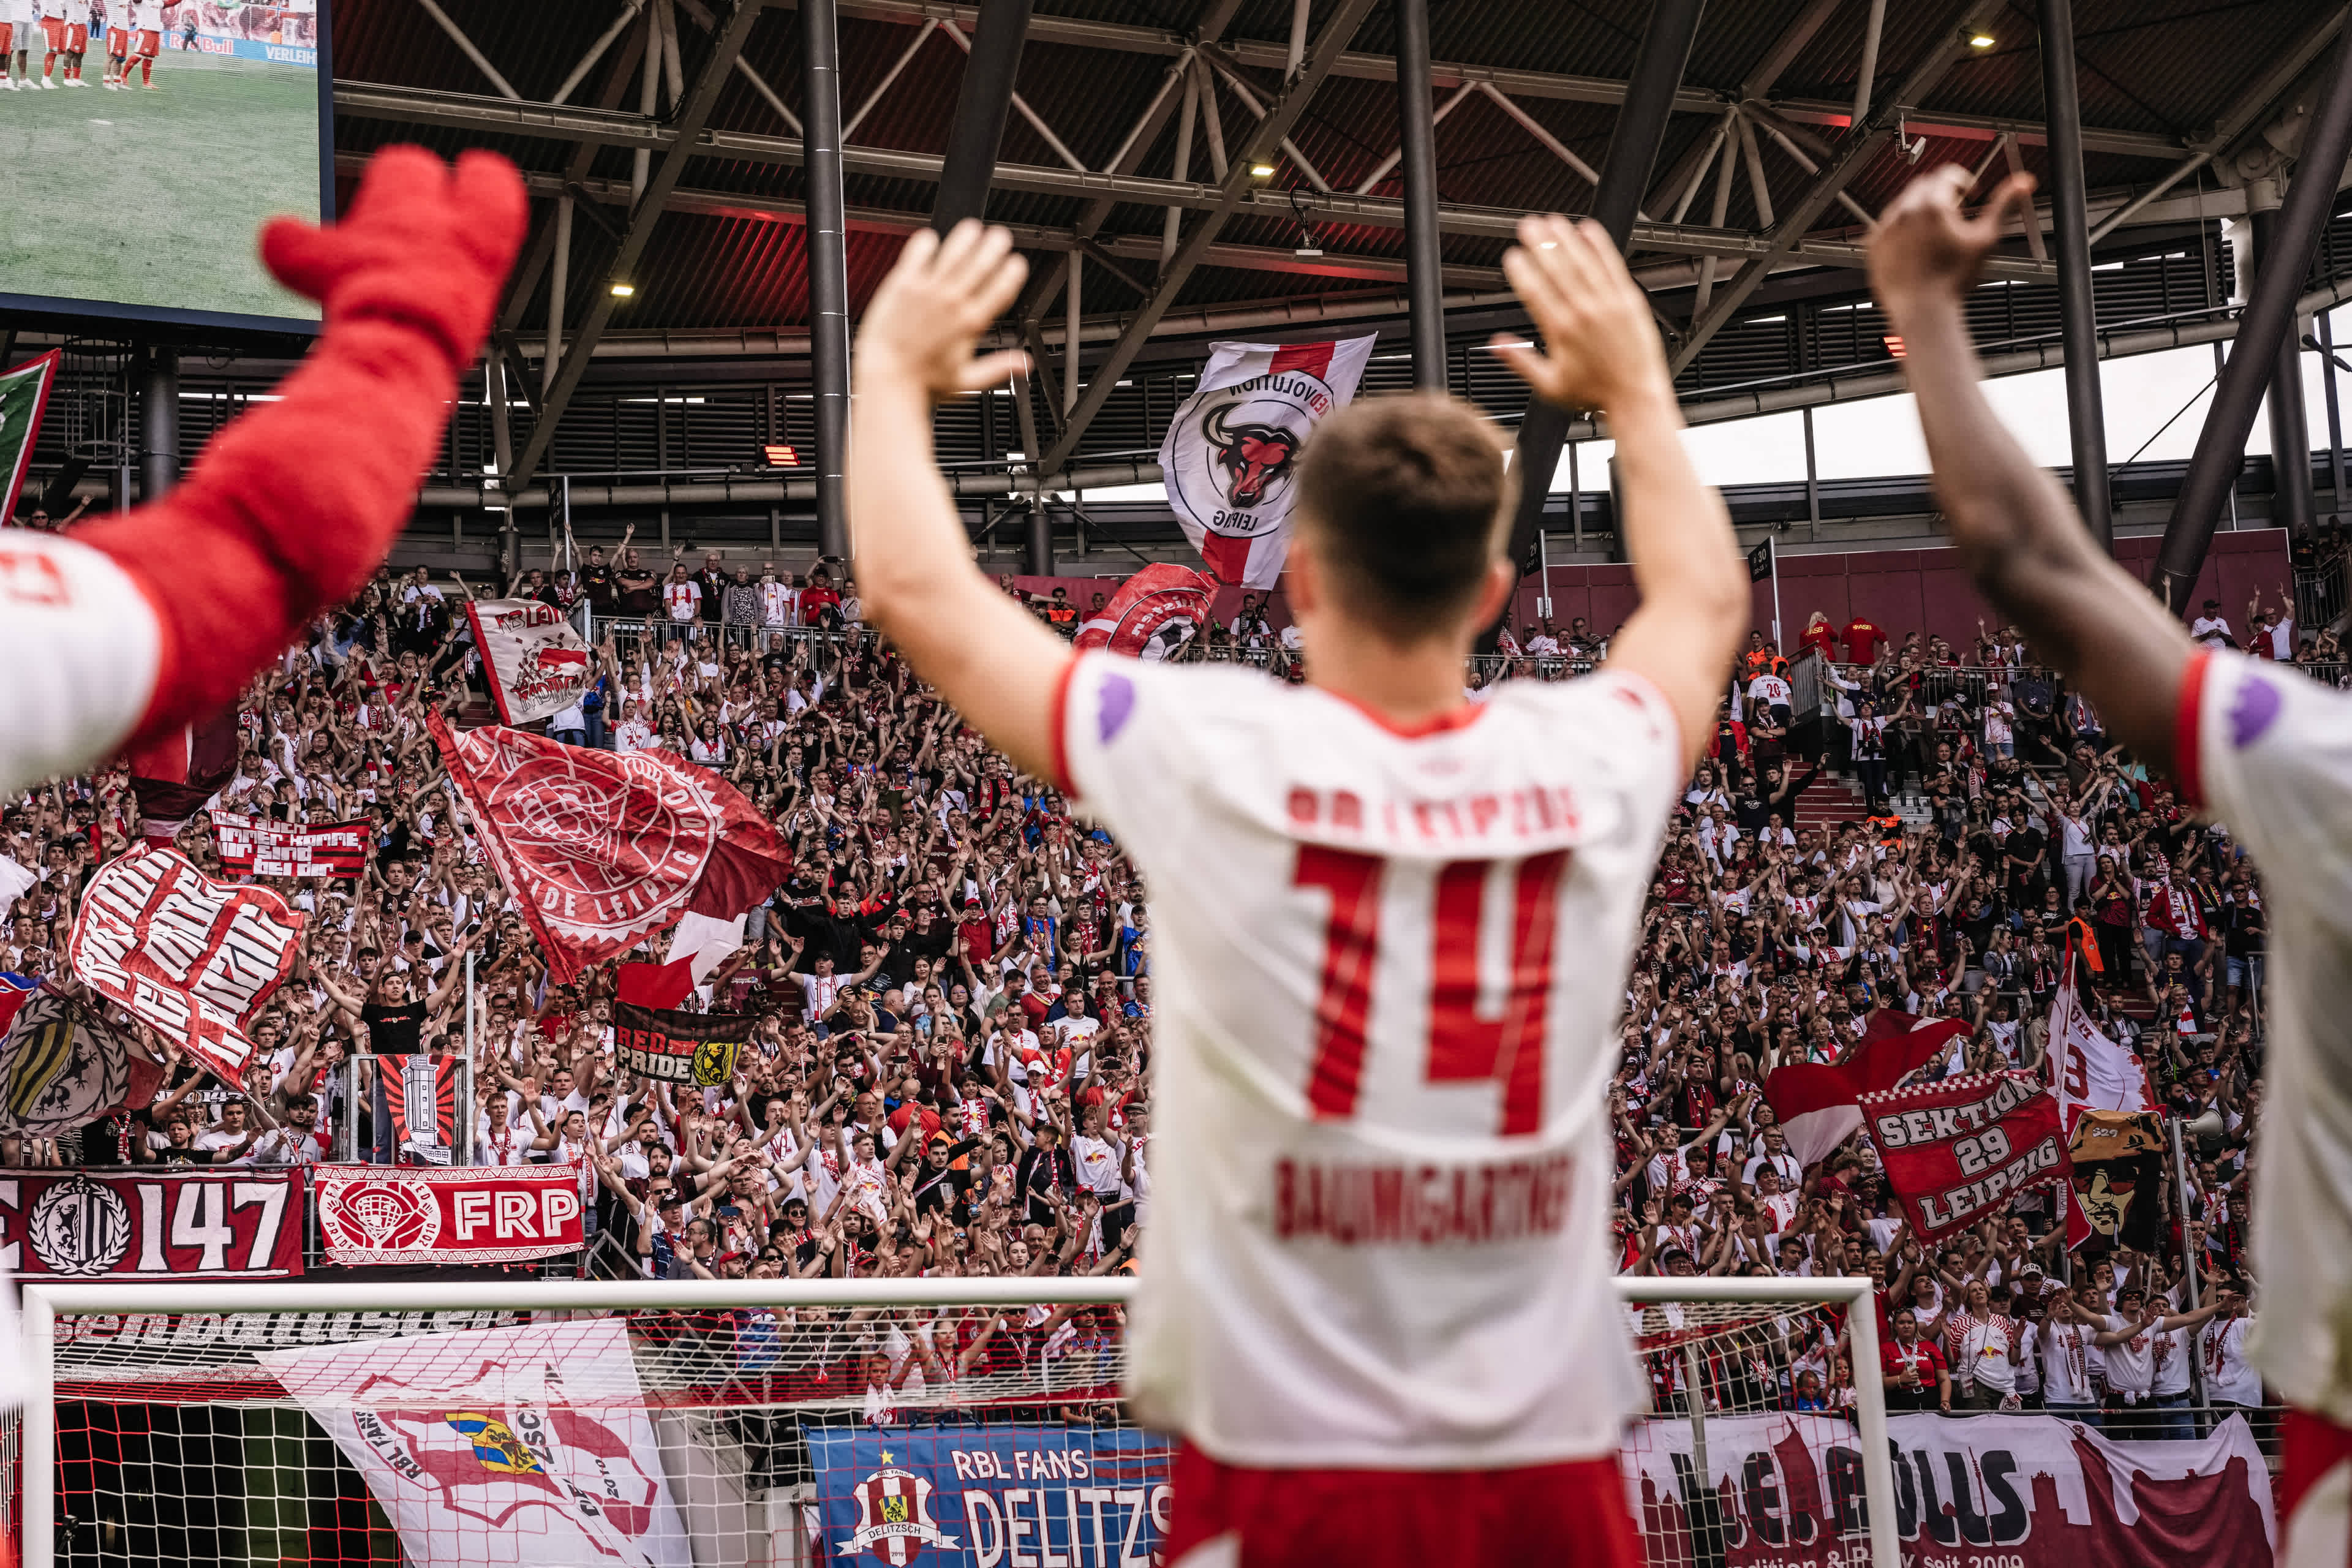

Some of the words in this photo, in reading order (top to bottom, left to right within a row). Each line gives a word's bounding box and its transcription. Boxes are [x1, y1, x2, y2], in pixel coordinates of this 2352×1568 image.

[203, 39, 234, 55] Bull
[1766, 683, 1781, 698] 20
[1291, 842, 1573, 1139] 14
[617, 1024, 667, 1054] RED
[616, 1042, 693, 1081] PRIDE
[1877, 1076, 2048, 1149] SEKTION
[2092, 1126, 2119, 1138] S29
[1953, 1125, 2012, 1178] 29
[70, 1186, 91, 1195] 147
[76, 1177, 85, 1187] 2
[1917, 1136, 2062, 1231] LEIPZIG
[137, 1182, 290, 1271] 147
[453, 1188, 579, 1240] FRP
[419, 1223, 437, 1247] 2010
[386, 1446, 424, 1480] RBL
[596, 1458, 619, 1499] 2010
[951, 1449, 1012, 1482] RBL
[1015, 1449, 1090, 1481] FANS
[868, 1524, 921, 1539] DELITZSCH
